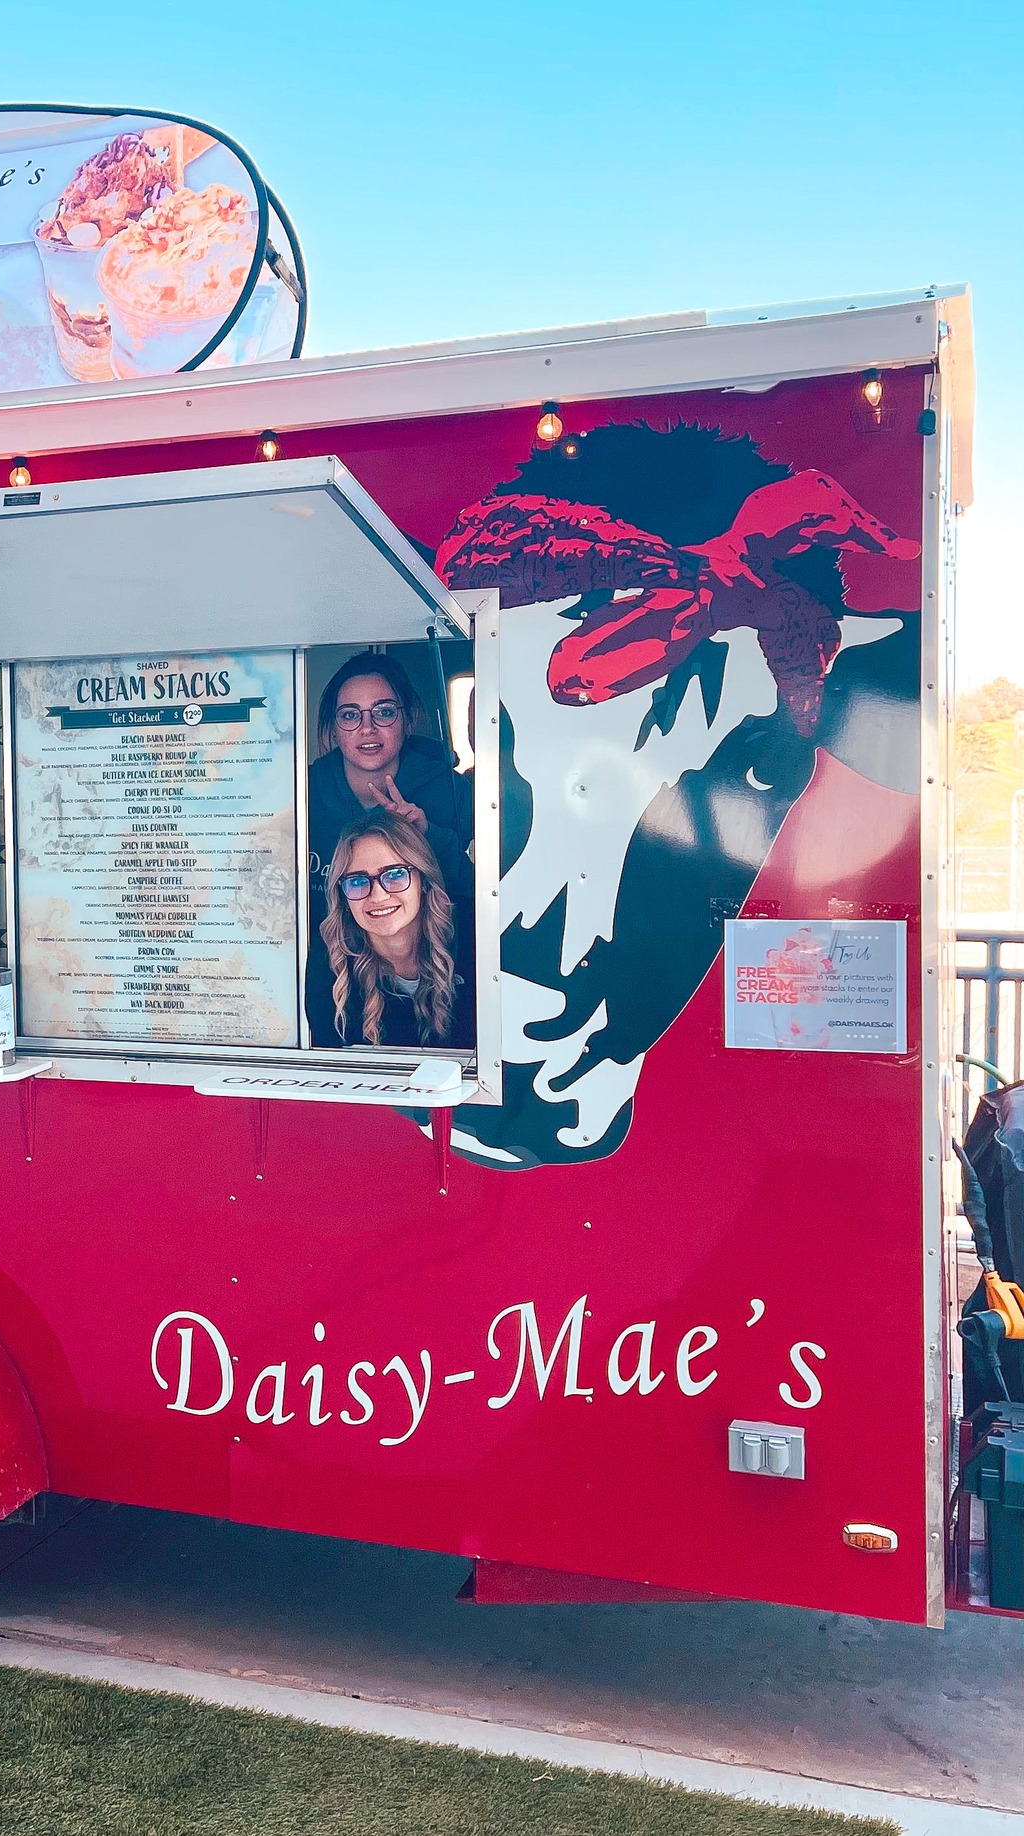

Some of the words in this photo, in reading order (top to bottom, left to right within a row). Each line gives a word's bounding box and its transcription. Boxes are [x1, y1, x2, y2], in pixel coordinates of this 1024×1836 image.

[136, 661, 169, 671] SHAVED
[77, 675, 146, 703] CREAM
[153, 671, 231, 699] STACKS
[147, 735, 163, 743] BARN
[165, 734, 186, 742] DANCE
[128, 753, 163, 761] RASPBERRY
[165, 752, 186, 760] ROUND
[189, 751, 197, 759] UP
[103, 771, 125, 779] BUTTER
[127, 771, 146, 779] PECAN
[149, 770, 158, 778] ICE
[161, 770, 182, 778] CREAM
[185, 769, 206, 777] SOCIAL
[125, 789, 148, 797] CHERRY
[150, 788, 160, 796] PIE
[162, 788, 184, 796] PICNIC
[128, 806, 150, 814] COOKIE
[132, 824, 148, 832] ELVIS
[150, 823, 178, 831] COUNTRY
[141, 841, 154, 849] FIRE
[155, 841, 189, 849] WRANGLER
[114, 859, 142, 867] CARAMEL
[145, 859, 164, 867] APPLE
[166, 859, 197, 867] TWO-STEP
[128, 877, 158, 885] CAMPFIRE
[160, 877, 183, 885] COFFEE
[122, 894, 161, 903] DREAMSICLE
[163, 895, 189, 903] HARVEST
[146, 912, 166, 920] PEACH
[168, 912, 197, 920] COBBLER
[119, 930, 146, 938] SHOTGUN
[147, 930, 176, 938] WEDDING
[178, 930, 194, 938] CAKE
[138, 947, 160, 955] BROWN
[161, 948, 175, 956] COW
[133, 965, 155, 973] GIMME
[737, 966, 777, 978] FREE
[825, 974, 841, 982] your
[844, 973, 875, 982] pictures
[877, 973, 894, 981] with
[123, 982, 163, 991] STRAWBERRY
[165, 983, 191, 991] SUNRISE
[736, 979, 795, 991] CREAM
[821, 984, 845, 992] stacks
[736, 991, 799, 1004] STACKS
[826, 995, 854, 1005] weekly
[855, 995, 889, 1006] drawing
[145, 1000, 162, 1009] BACK
[163, 1001, 184, 1009] RODEO
[222, 1077, 344, 1089] ORDER
[150, 1293, 827, 1447] Daisy-Mae's
